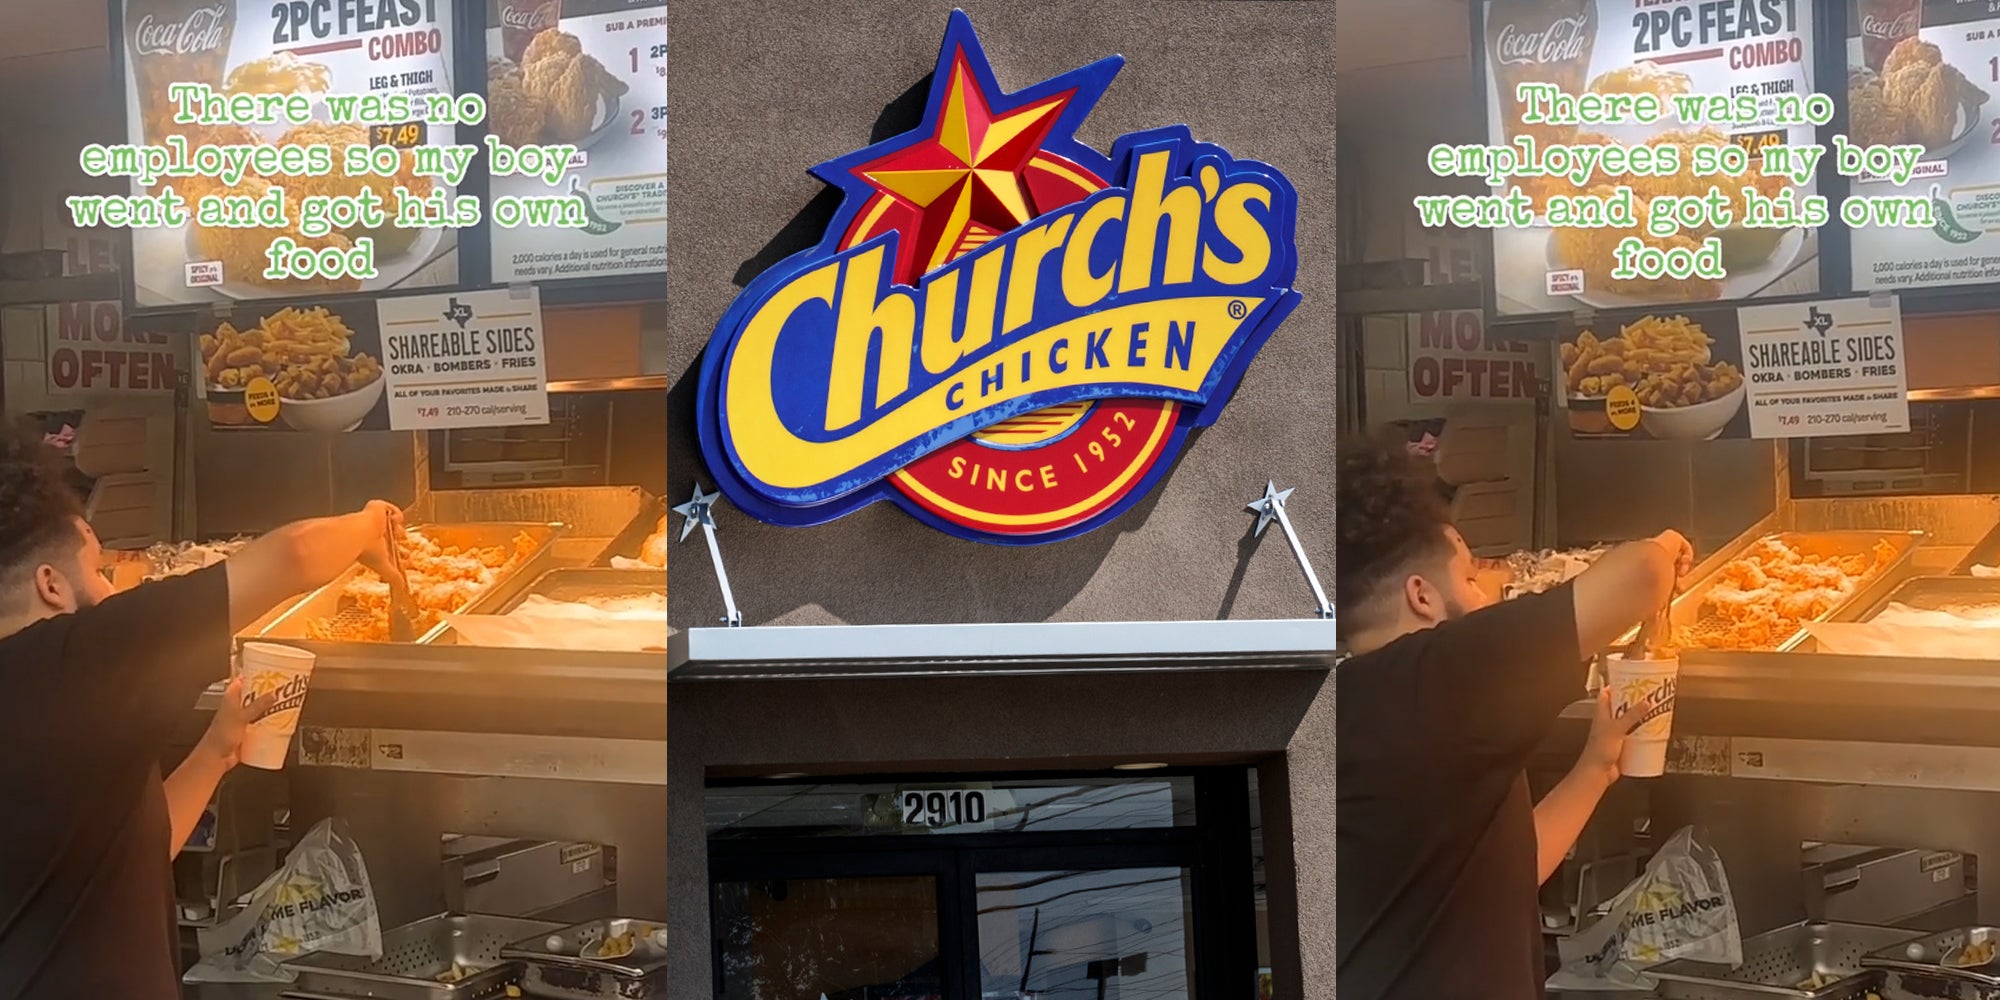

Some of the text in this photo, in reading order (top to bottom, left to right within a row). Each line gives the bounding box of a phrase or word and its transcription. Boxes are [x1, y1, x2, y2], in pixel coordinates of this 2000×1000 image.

[272, 0, 437, 45] 2PC FEAST
[605, 22, 625, 32] SUB
[627, 21, 635, 30] A
[1632, 0, 1797, 54] 2PC FEAST
[368, 28, 442, 61] COMBO
[1729, 37, 1802, 70] COMBO
[629, 47, 639, 73] 1
[1989, 56, 1998, 82] 1
[369, 69, 433, 90] LEG & THIGH
[1761, 79, 1794, 95] THIGH
[376, 124, 419, 145] $7.49
[630, 109, 645, 135] 2
[535, 252, 562, 262] calories
[569, 251, 581, 261] day
[591, 249, 607, 258] used
[609, 248, 619, 256] for
[620, 246, 648, 258] general
[1895, 261, 1922, 270] calories
[514, 266, 536, 276] needs
[554, 262, 590, 273] Additional
[592, 260, 623, 270] nutrition
[1914, 271, 1951, 281] Additional
[454, 307, 468, 317] XL
[728, 150, 1271, 487] Church's
[1814, 316, 1828, 326] XL
[388, 327, 535, 360] SHAREABLE SIDES
[1749, 335, 1895, 368] SHAREABLE SIDES
[52, 347, 176, 390] OFTEN
[391, 357, 536, 375] OKRA BOMBERS FRIES
[945, 320, 1196, 411] CHICKEN
[1413, 356, 1536, 399] OFTEN
[1752, 365, 1896, 383] OKRA BOMBERS FRIES
[442, 388, 481, 396] FAVORITES
[512, 384, 537, 392] SHARE
[1802, 396, 1841, 404] FAVORITES
[1872, 392, 1898, 400] SHARE
[417, 404, 528, 417] $7.49 210-270 cal/serving
[1808, 414, 1840, 424] 210-270
[1842, 412, 1888, 424] cal/serving
[947, 411, 1136, 492] SINCE 1952
[904, 791, 986, 827] 2910
[300, 888, 365, 914] FLAVOR
[1660, 895, 1725, 922] FLAVOR
